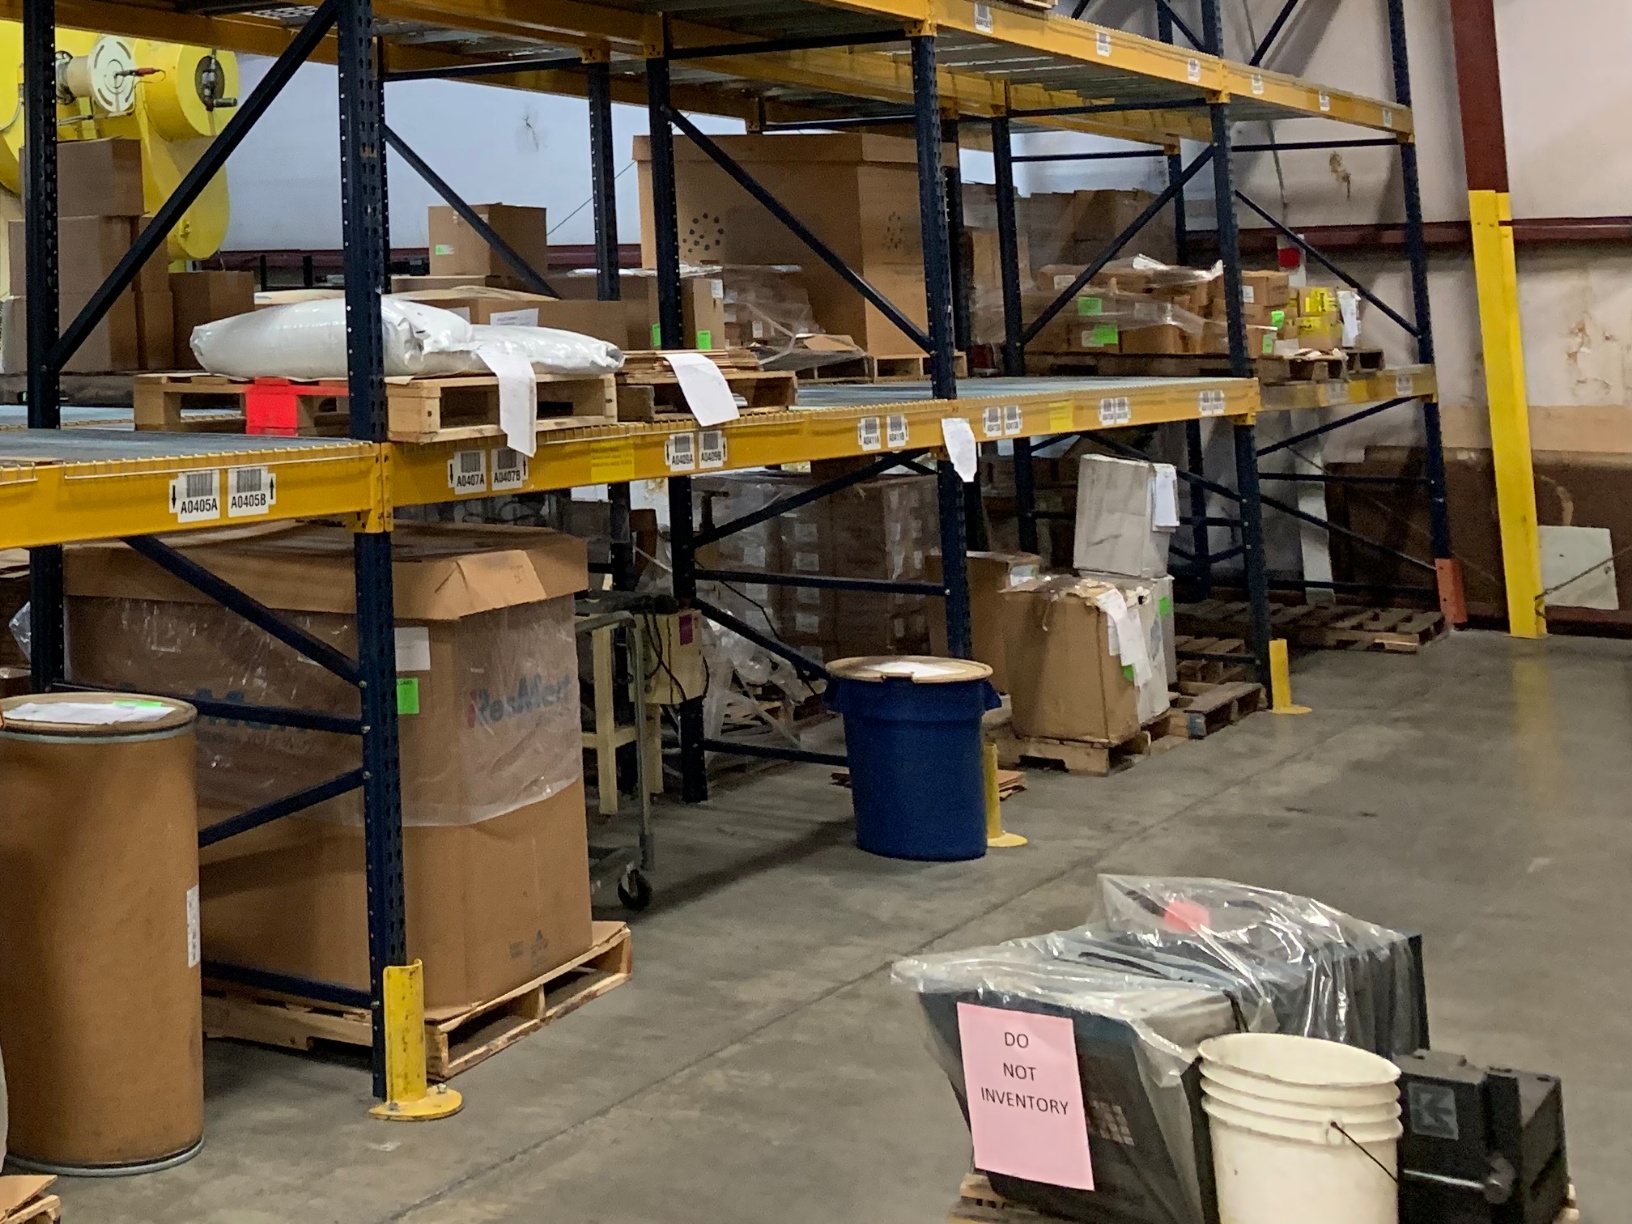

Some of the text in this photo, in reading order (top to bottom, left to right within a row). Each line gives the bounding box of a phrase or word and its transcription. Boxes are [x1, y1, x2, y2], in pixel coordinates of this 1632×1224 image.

[671, 454, 694, 466] A0409A
[700, 450, 722, 462] A0409B
[456, 474, 485, 487] A0407A
[493, 469, 521, 482] A0407B
[180, 498, 218, 514] A0405A
[231, 493, 267, 509] A0405B
[1004, 1032, 1029, 1048] DO
[1003, 1062, 1036, 1082] NOT
[981, 1087, 1069, 1116] INVENTORY
